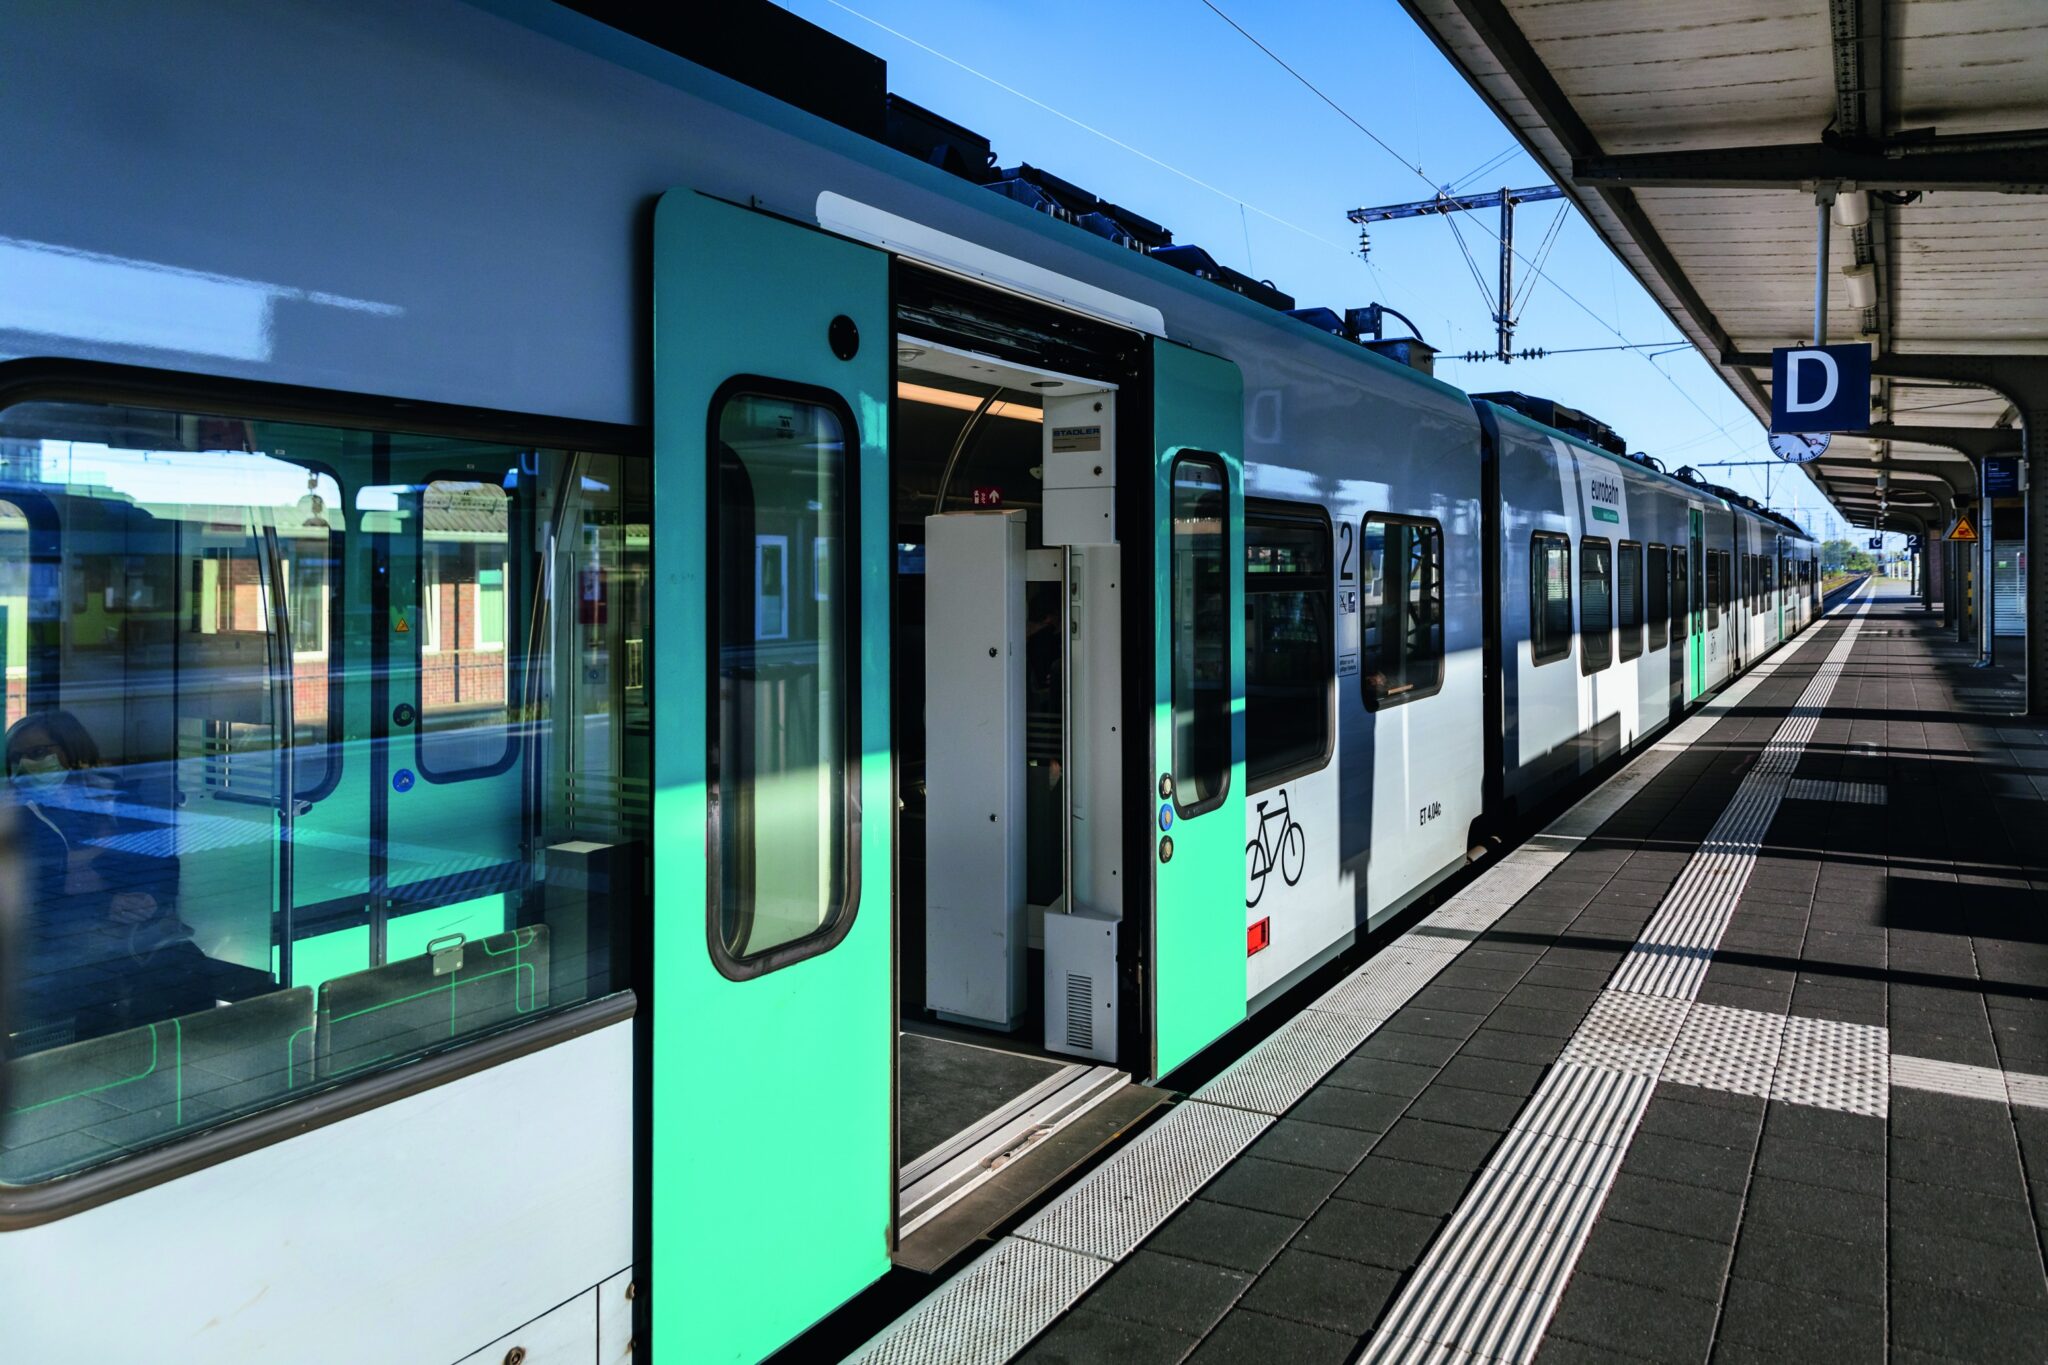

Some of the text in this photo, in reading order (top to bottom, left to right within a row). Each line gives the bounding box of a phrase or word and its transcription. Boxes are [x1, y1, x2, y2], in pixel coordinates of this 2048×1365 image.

[1786, 350, 1839, 413] D
[1053, 428, 1100, 436] STADLER
[1592, 476, 1619, 505] eurobahn
[1340, 521, 1353, 580] 2
[1908, 534, 1917, 546] 2
[1420, 807, 1427, 826] ET
